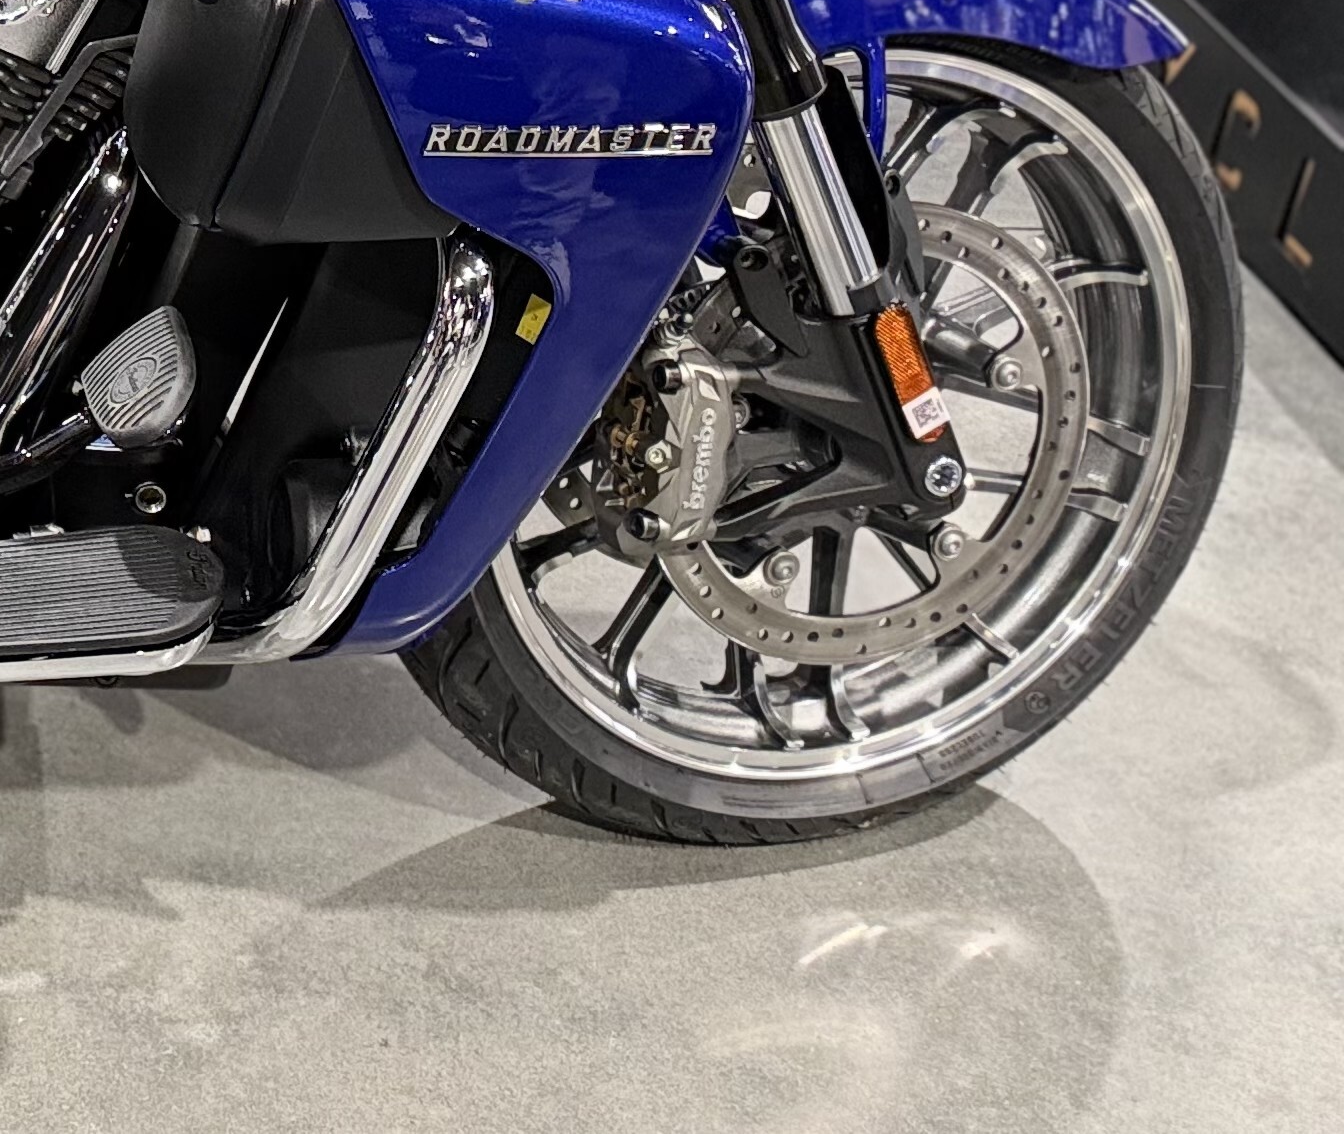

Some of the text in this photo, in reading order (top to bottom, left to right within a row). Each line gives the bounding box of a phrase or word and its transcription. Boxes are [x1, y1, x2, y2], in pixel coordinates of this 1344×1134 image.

[425, 122, 717, 153] ROADMASTER
[682, 407, 717, 510] brembo
[1050, 494, 1194, 692] METZELER
